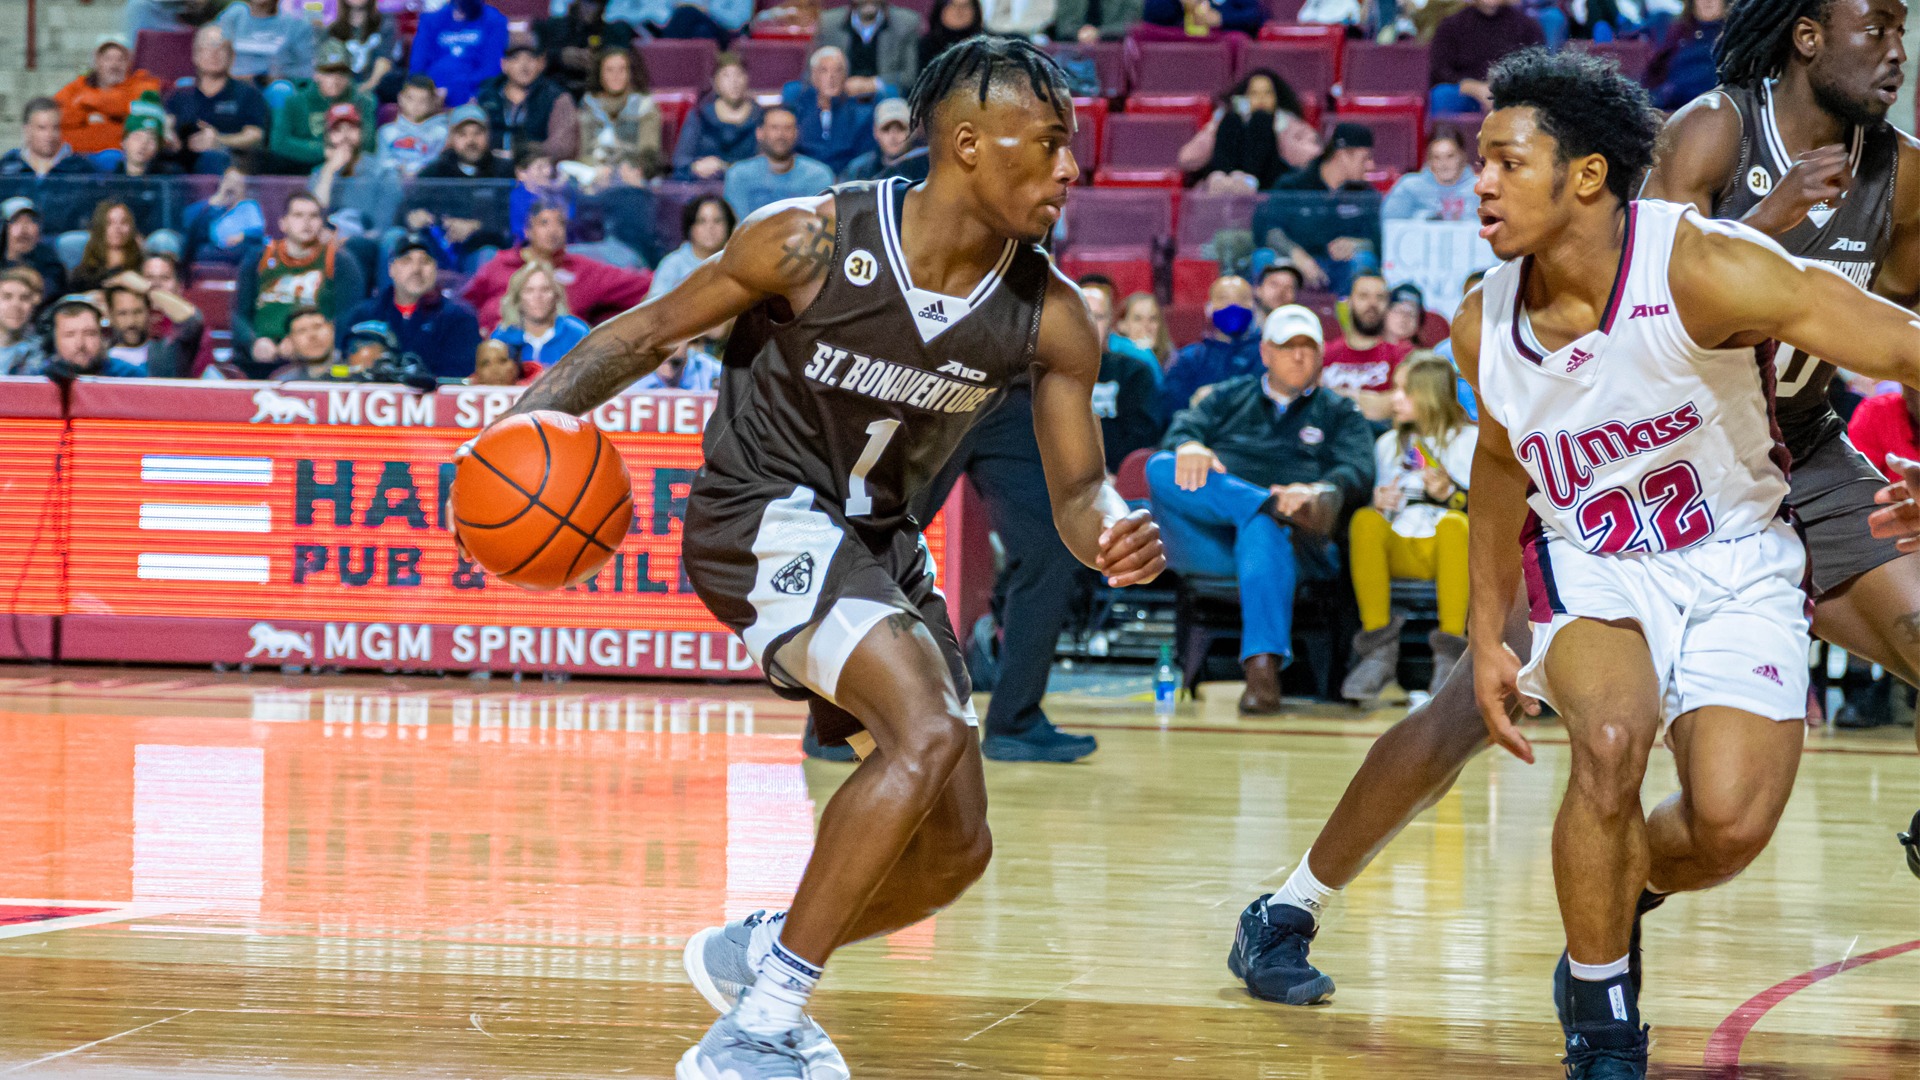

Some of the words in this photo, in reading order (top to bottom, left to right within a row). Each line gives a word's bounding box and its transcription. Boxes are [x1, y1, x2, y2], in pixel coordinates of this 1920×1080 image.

[1751, 171, 1768, 190] 31
[1828, 237, 1867, 252] A10
[848, 256, 872, 281] 31
[918, 309, 949, 324] adidas
[1628, 303, 1670, 320] A10
[936, 359, 988, 382] A10
[1565, 352, 1595, 373] adidas
[804, 341, 849, 387] ST.
[839, 353, 999, 414] BONAVENTURE
[328, 389, 435, 427] MGM
[845, 417, 902, 518] 1
[1576, 459, 1715, 552] 22
[293, 544, 423, 587] PUB
[324, 622, 432, 662] MGM
[451, 624, 754, 671] SPRINGFIELD
